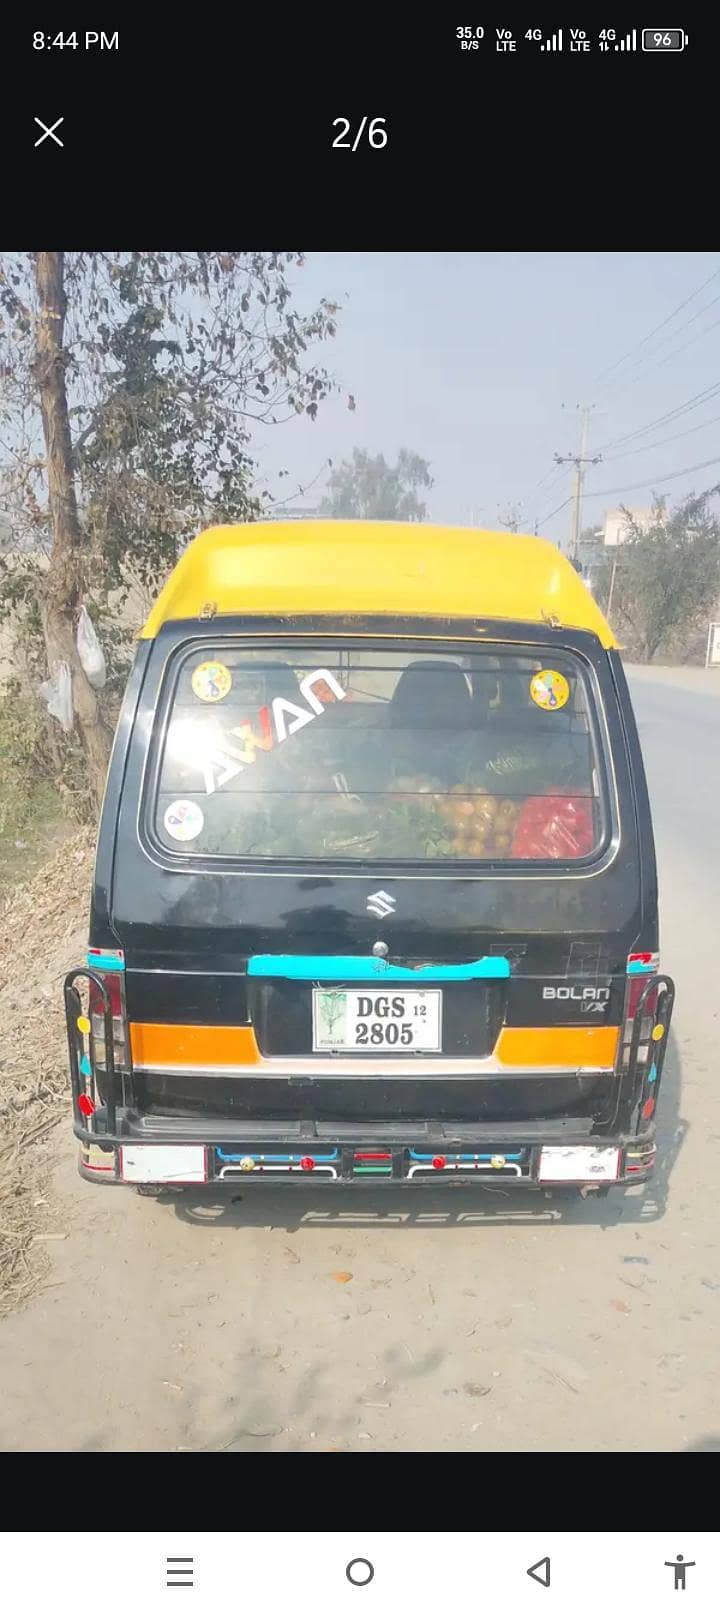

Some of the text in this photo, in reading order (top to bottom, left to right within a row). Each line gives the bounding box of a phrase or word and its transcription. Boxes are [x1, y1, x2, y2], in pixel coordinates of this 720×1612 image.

[542, 986, 610, 999] BOLAN
[356, 996, 427, 1018] DGS 12
[355, 1023, 413, 1045] 2805
